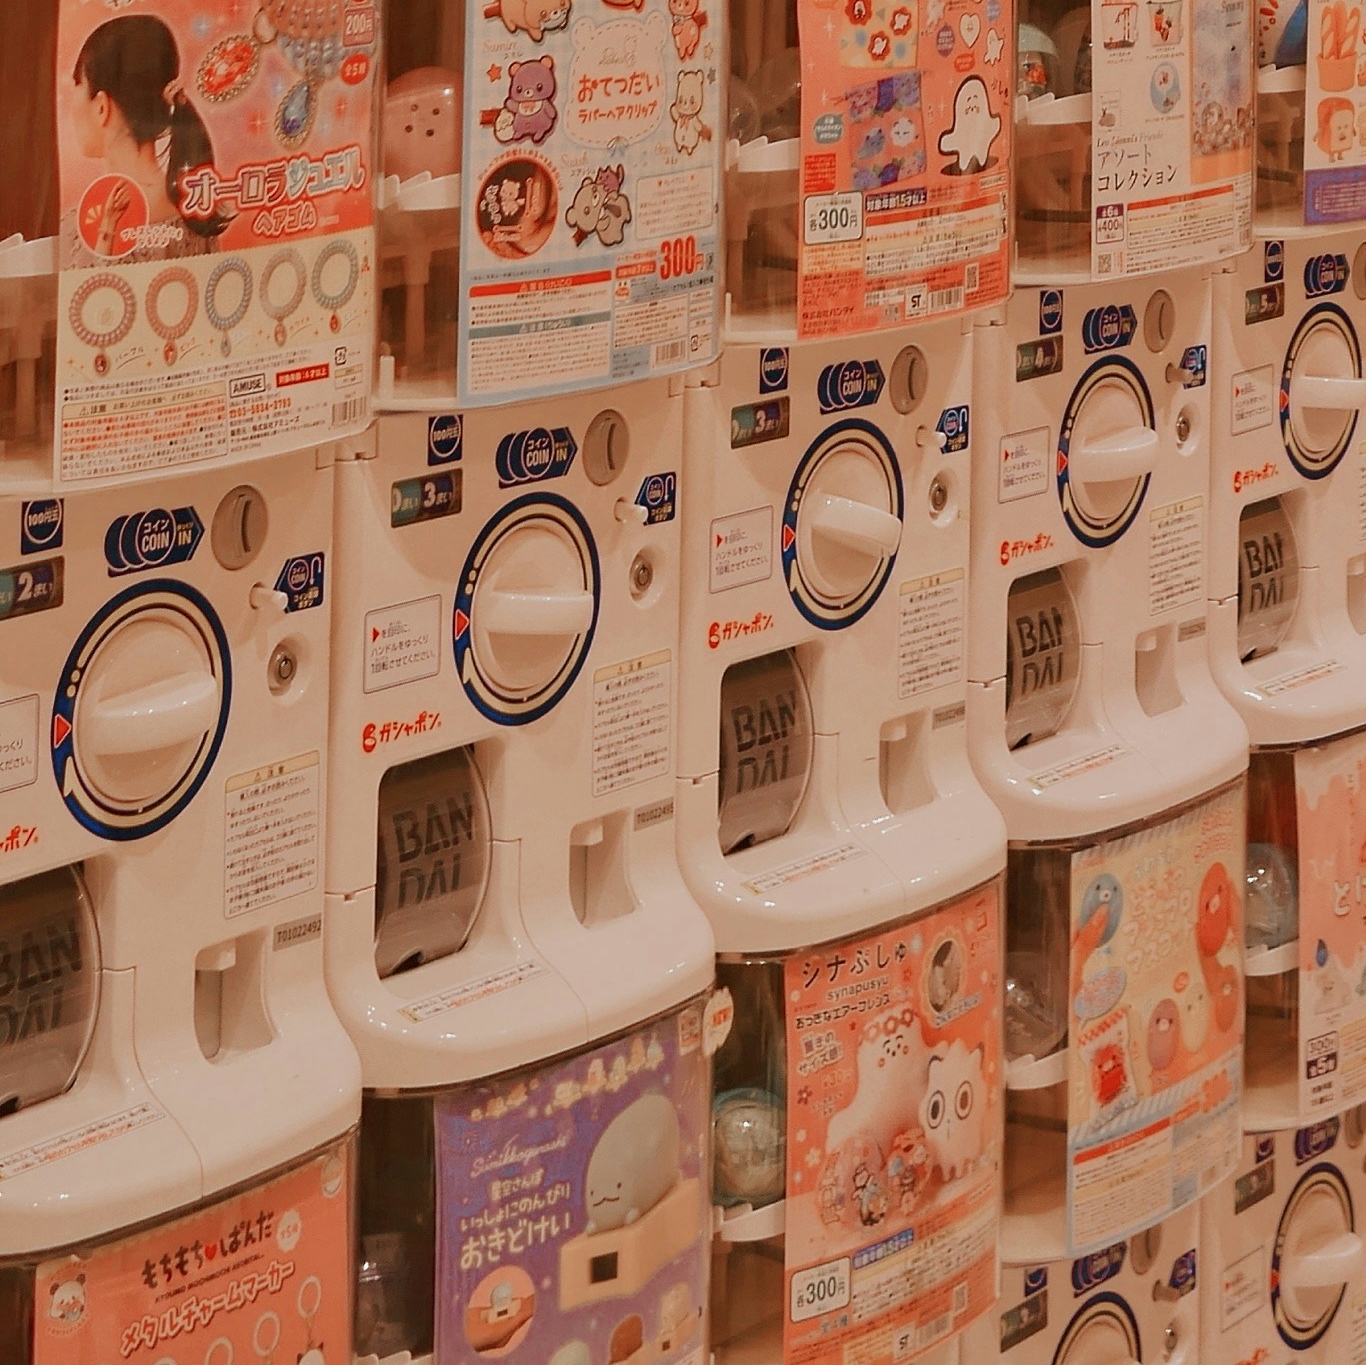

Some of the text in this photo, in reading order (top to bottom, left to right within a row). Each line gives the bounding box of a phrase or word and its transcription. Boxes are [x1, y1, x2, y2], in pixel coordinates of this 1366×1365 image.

[578, 72, 660, 103] おてつだい
[1097, 143, 1152, 170] アソート
[1097, 164, 1178, 193] コレクション
[252, 200, 319, 236] ヘアゴム
[842, 368, 863, 381] コイン
[866, 376, 878, 392] IN
[232, 379, 265, 395] AMUSE
[841, 378, 863, 396] COIN
[526, 438, 549, 451] コイン
[555, 446, 568, 462] IN
[525, 448, 550, 468] COIN
[27, 507, 61, 526] 100円玉
[142, 519, 169, 534] コイン
[140, 531, 170, 552] COIN
[177, 529, 192, 547] IN
[370, 634, 429, 657] ハンドルをゆっくり
[730, 689, 797, 753] BAN
[392, 791, 474, 864] BAN
[397, 852, 462, 910] DAI
[277, 919, 322, 945] T01022492
[801, 942, 907, 989] シナぷしゅ
[826, 976, 889, 1002] synapusyu
[460, 1211, 571, 1271] おきどけい
